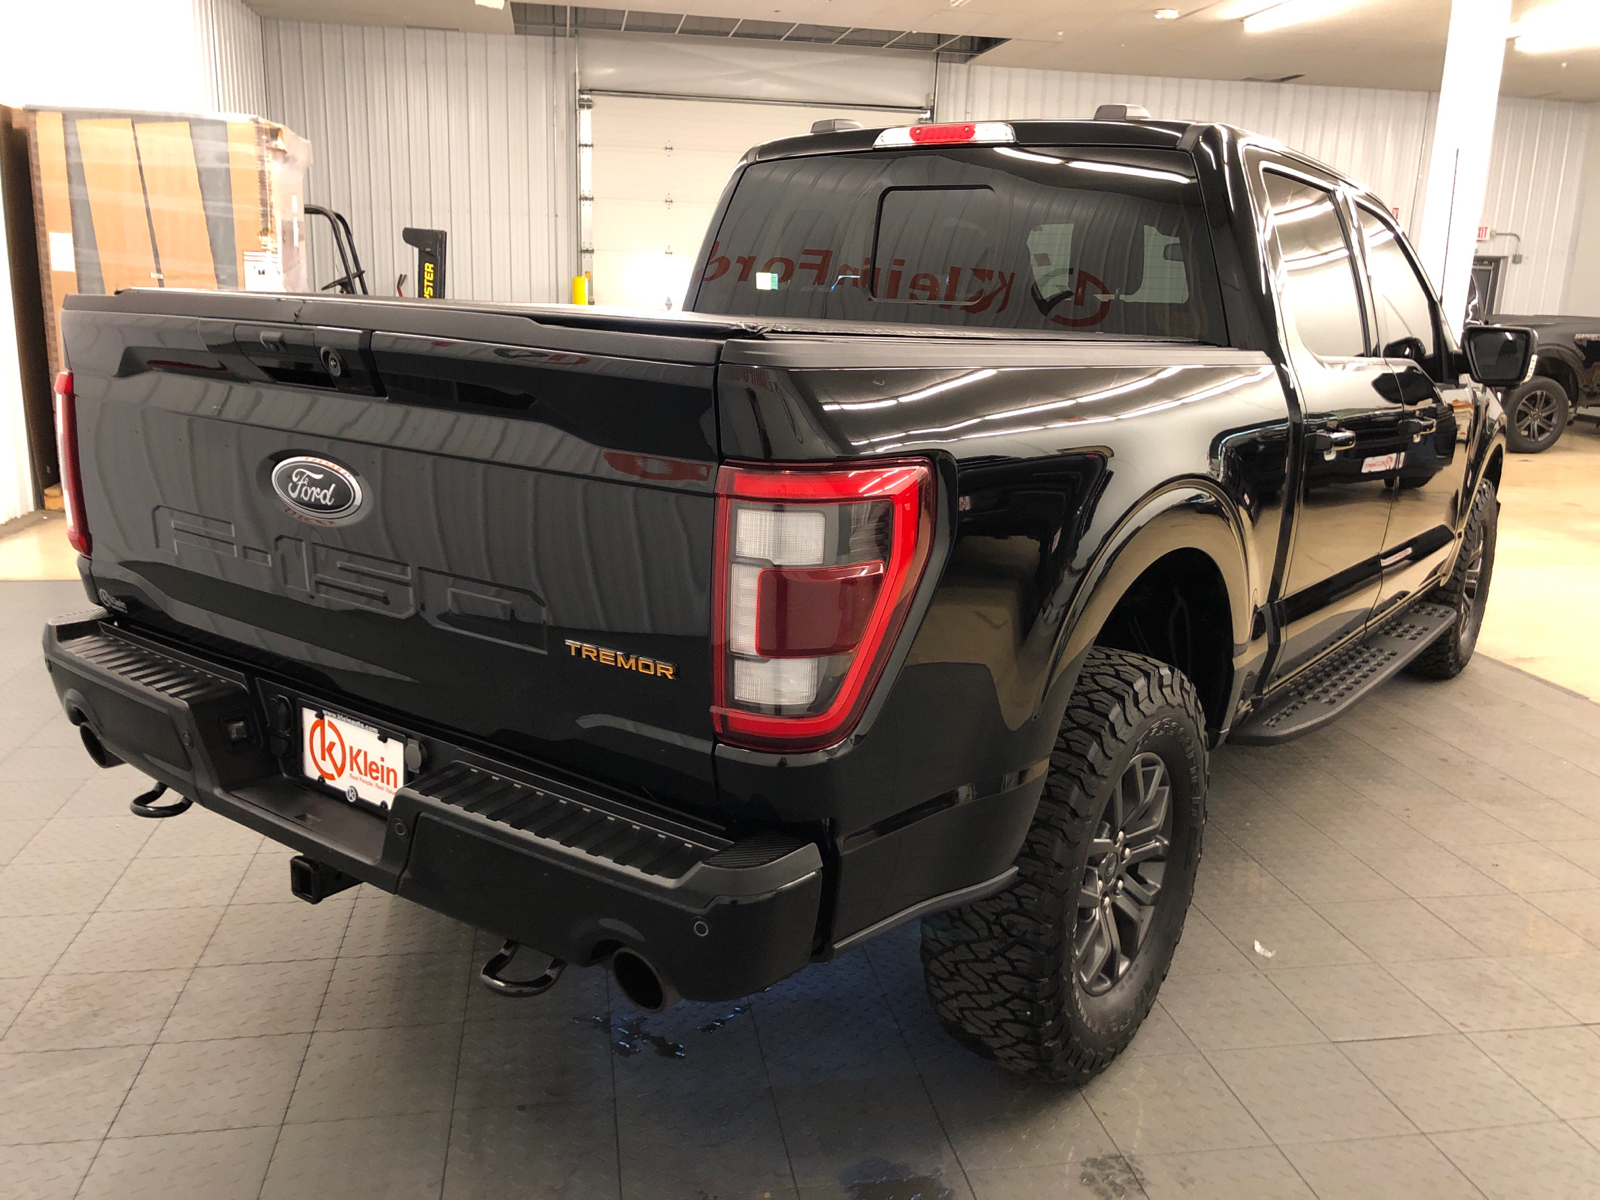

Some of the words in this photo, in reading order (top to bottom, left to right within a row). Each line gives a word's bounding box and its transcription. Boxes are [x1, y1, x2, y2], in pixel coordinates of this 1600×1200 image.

[423, 262, 434, 299] STER
[288, 468, 336, 505] Ford
[152, 505, 548, 654] F-150
[564, 639, 679, 680] TREMOR
[349, 745, 398, 789] Klein
